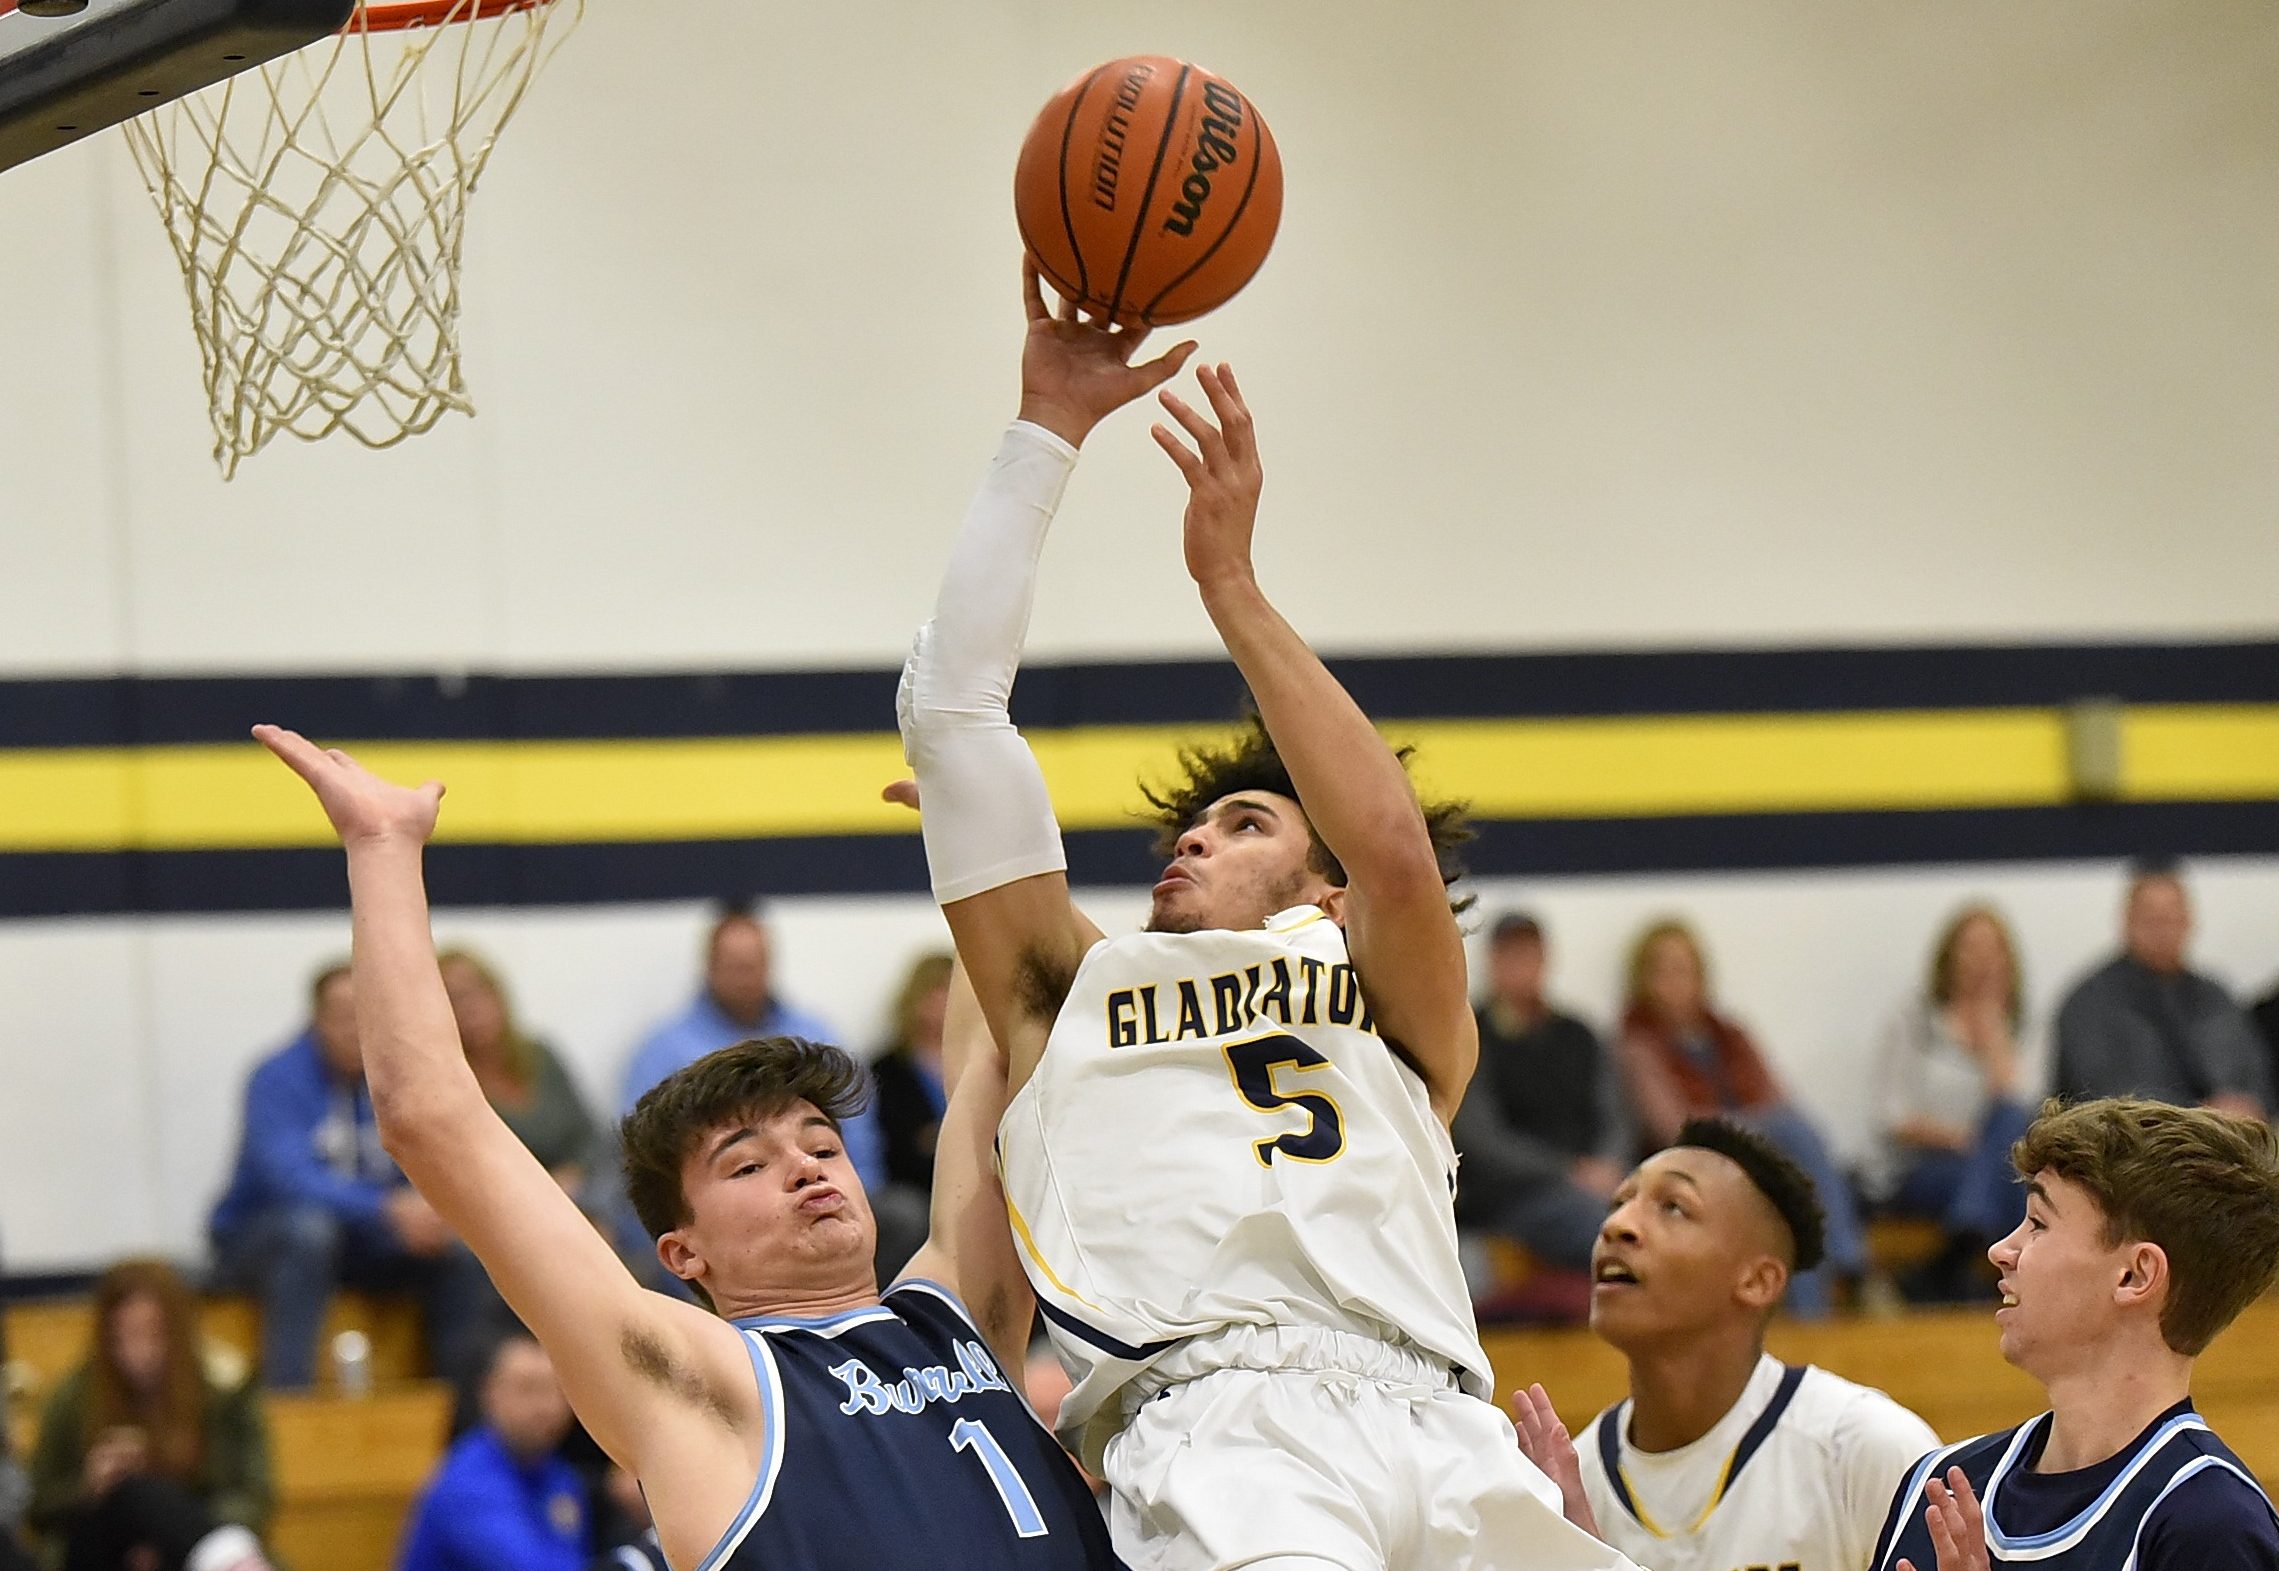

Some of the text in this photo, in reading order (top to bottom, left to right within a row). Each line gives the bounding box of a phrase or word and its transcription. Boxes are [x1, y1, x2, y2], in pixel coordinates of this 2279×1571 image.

[1094, 64, 1157, 212] EVOLUTION
[1162, 80, 1242, 237] Wilson
[1105, 956, 1377, 1050] GLADIATO
[1220, 1030, 1347, 1169] 5
[948, 1417, 1050, 1538] 1
